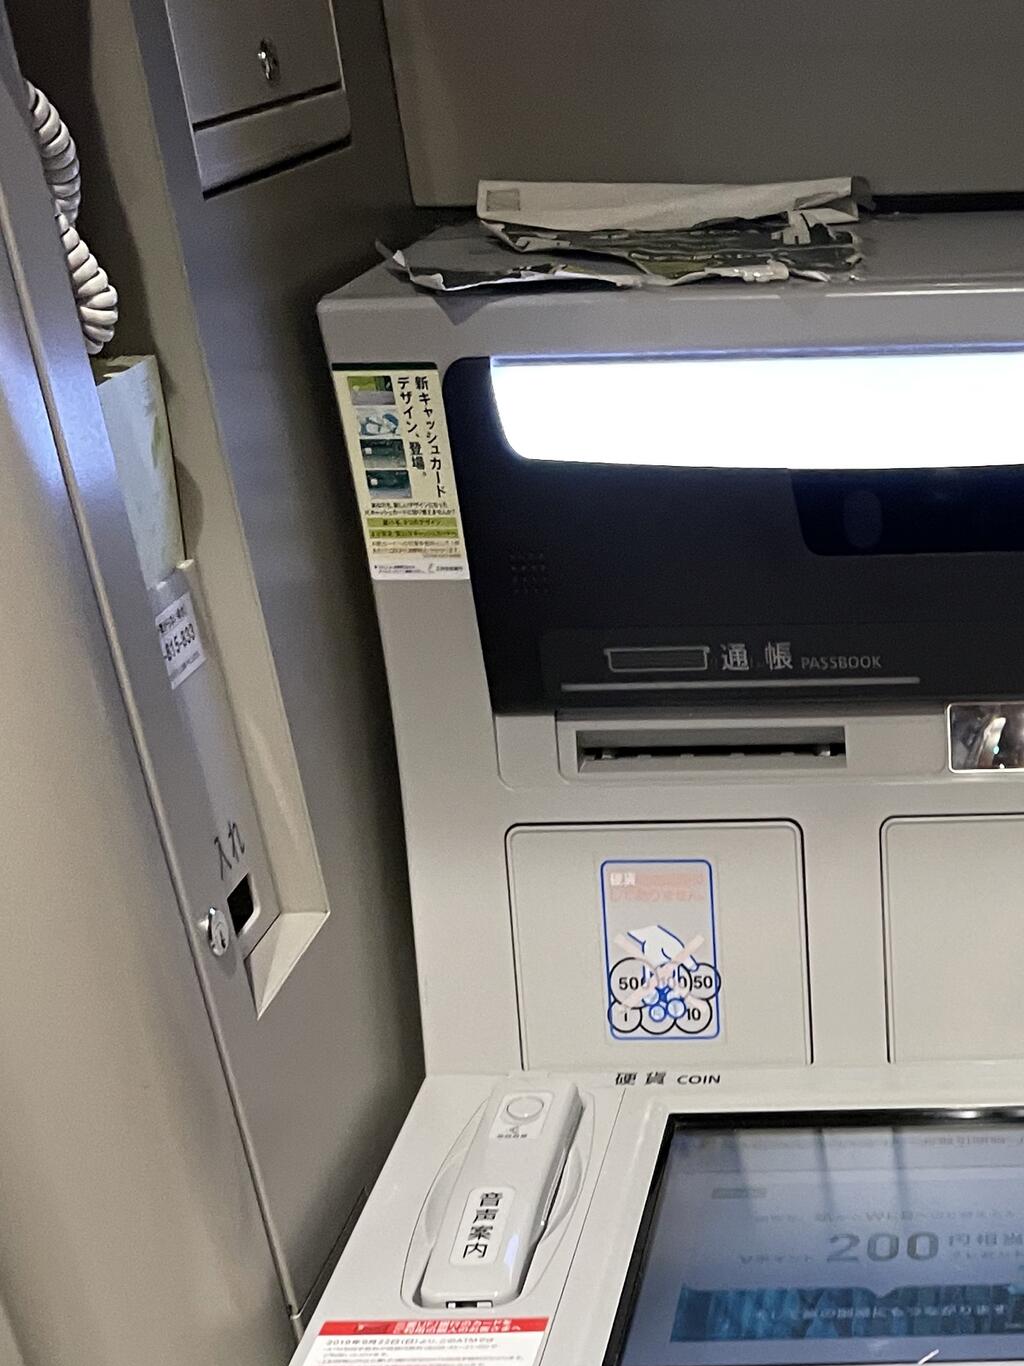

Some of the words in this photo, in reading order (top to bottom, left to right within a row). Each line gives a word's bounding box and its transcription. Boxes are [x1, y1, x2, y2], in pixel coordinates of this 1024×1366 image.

[415, 376, 446, 497] 新キャッシュカード
[720, 641, 793, 670] 通帳
[801, 655, 882, 671] PASSBOOK
[693, 975, 713, 989] 50
[676, 1074, 721, 1085] COIN
[462, 1191, 503, 1259] 音声案内
